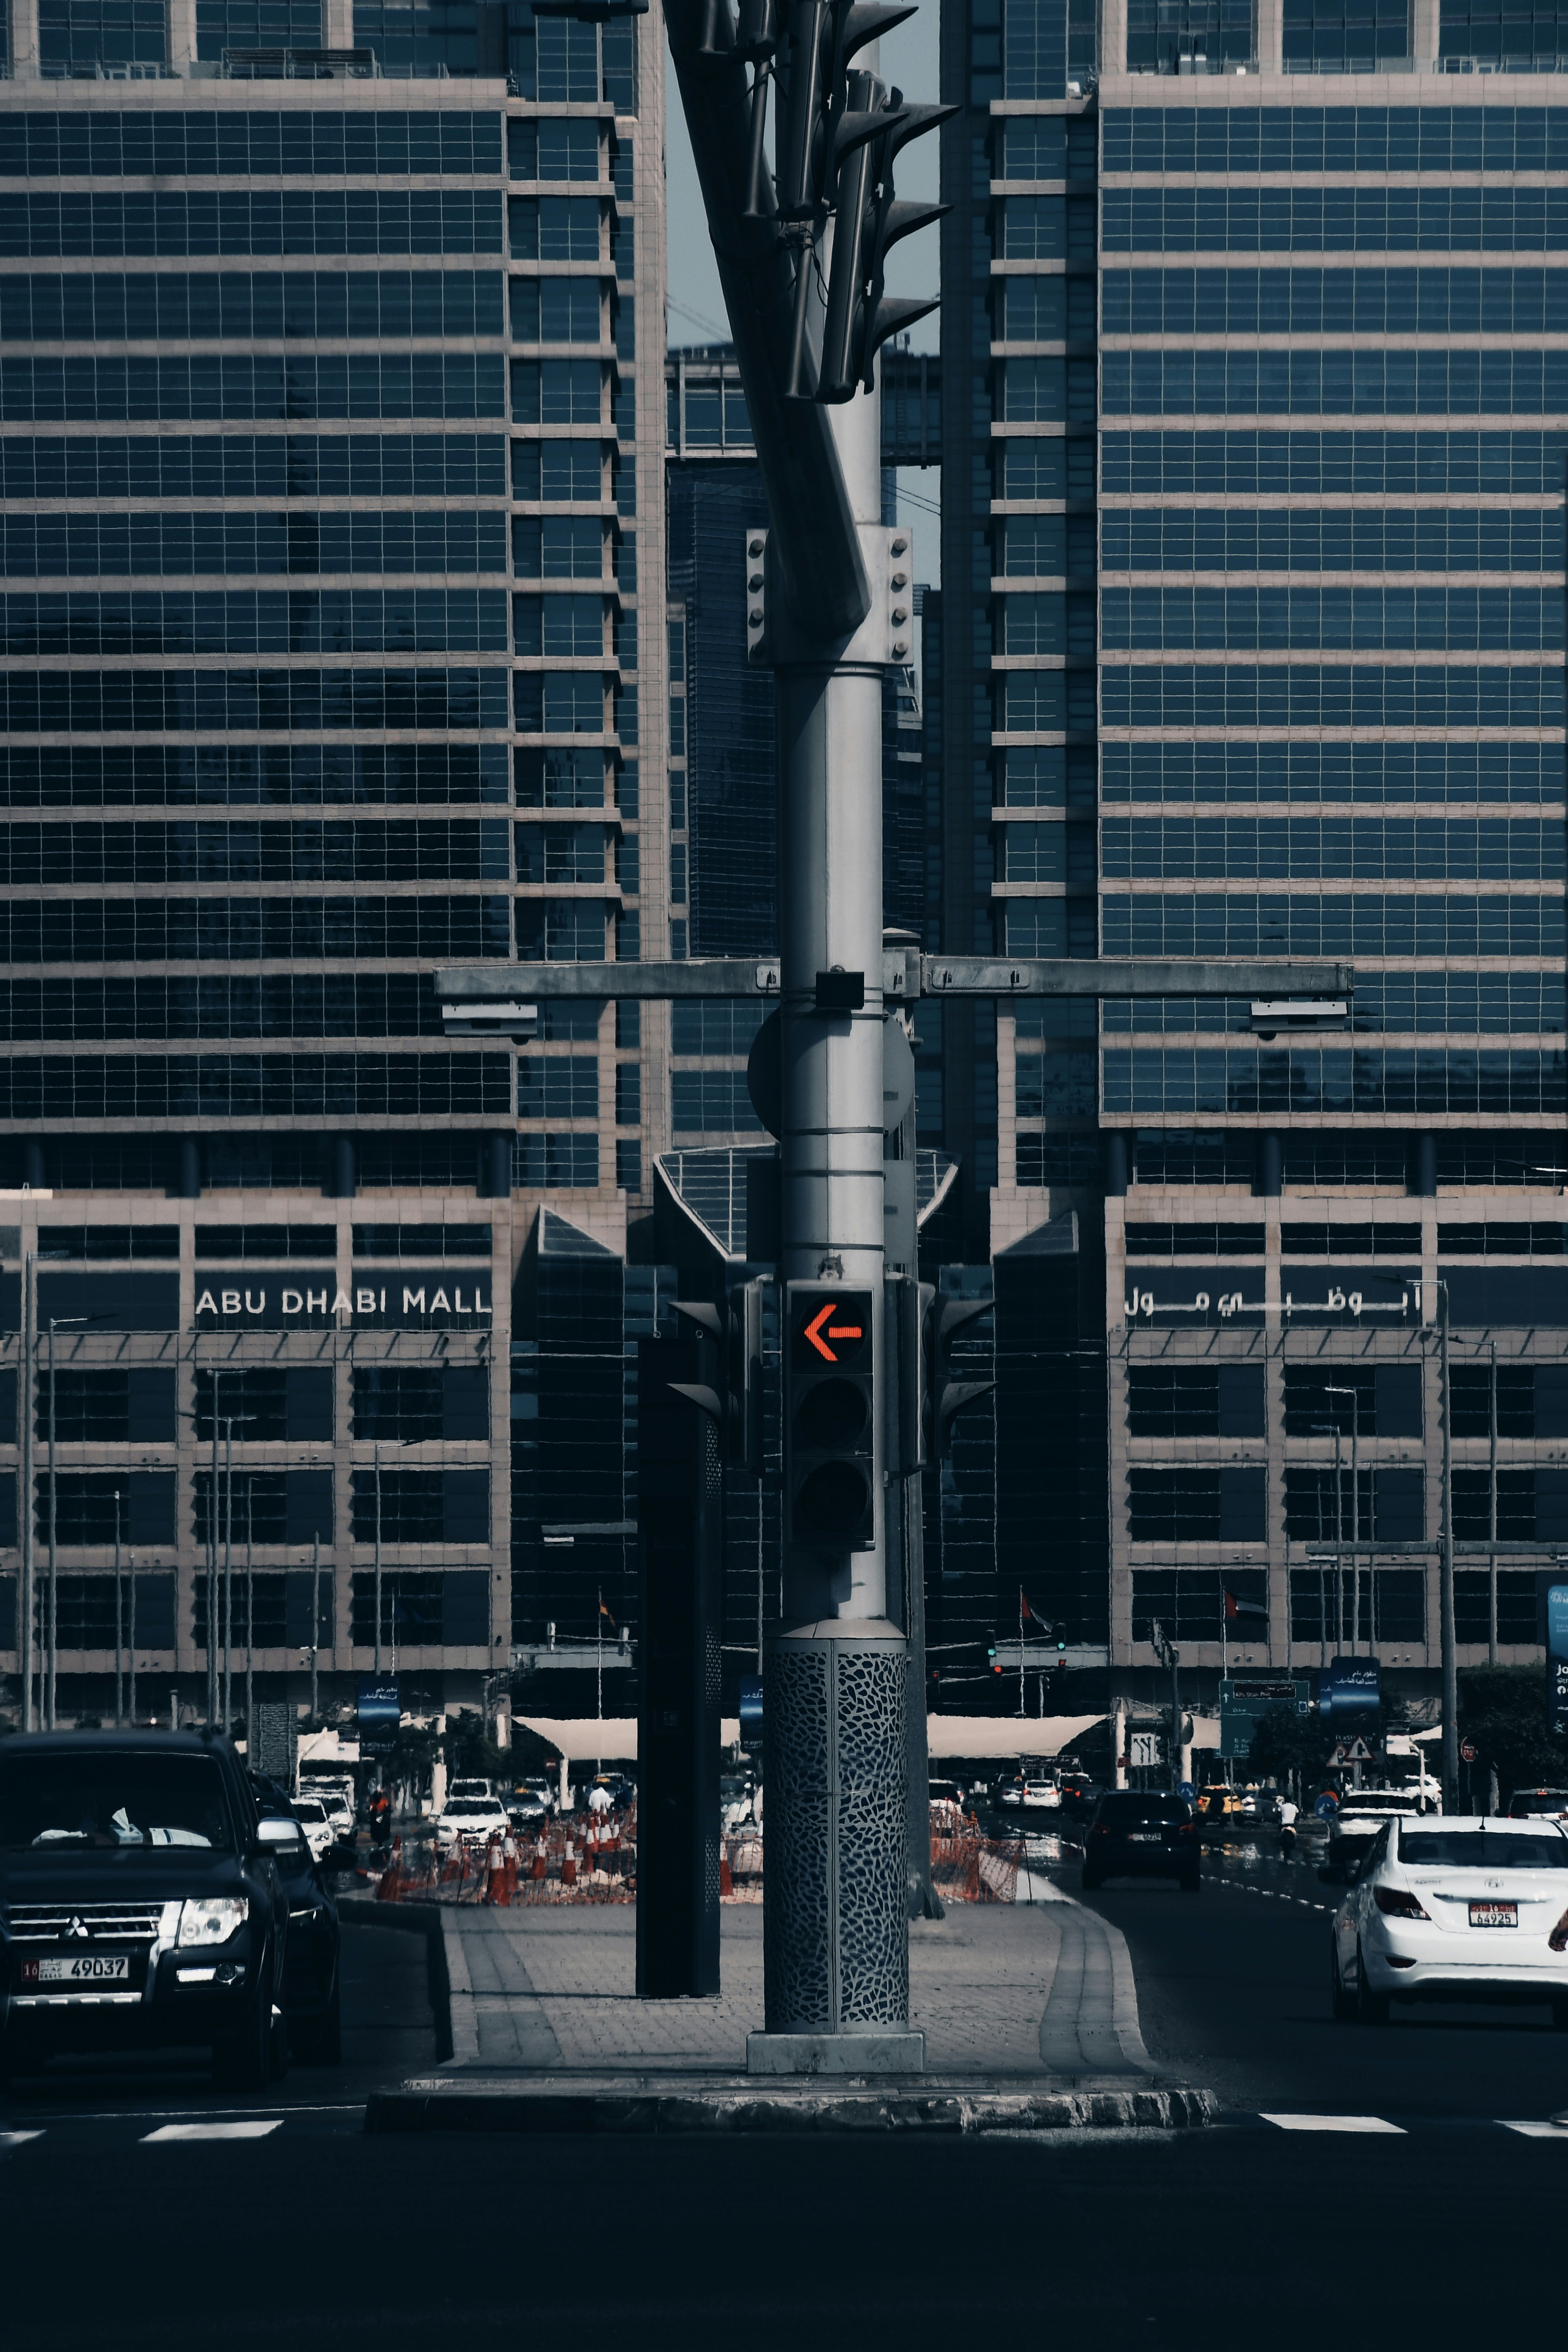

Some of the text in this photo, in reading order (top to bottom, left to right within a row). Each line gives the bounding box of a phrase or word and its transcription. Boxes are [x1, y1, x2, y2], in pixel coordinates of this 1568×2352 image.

[195, 1285, 492, 1314] ABU DHABI MALL
[1124, 1286, 1210, 1317] مول
[1489, 1904, 1498, 1912] 16
[1477, 1913, 1511, 1923] 64925
[24, 1963, 38, 1976] 16
[71, 1959, 125, 1976] 49037
